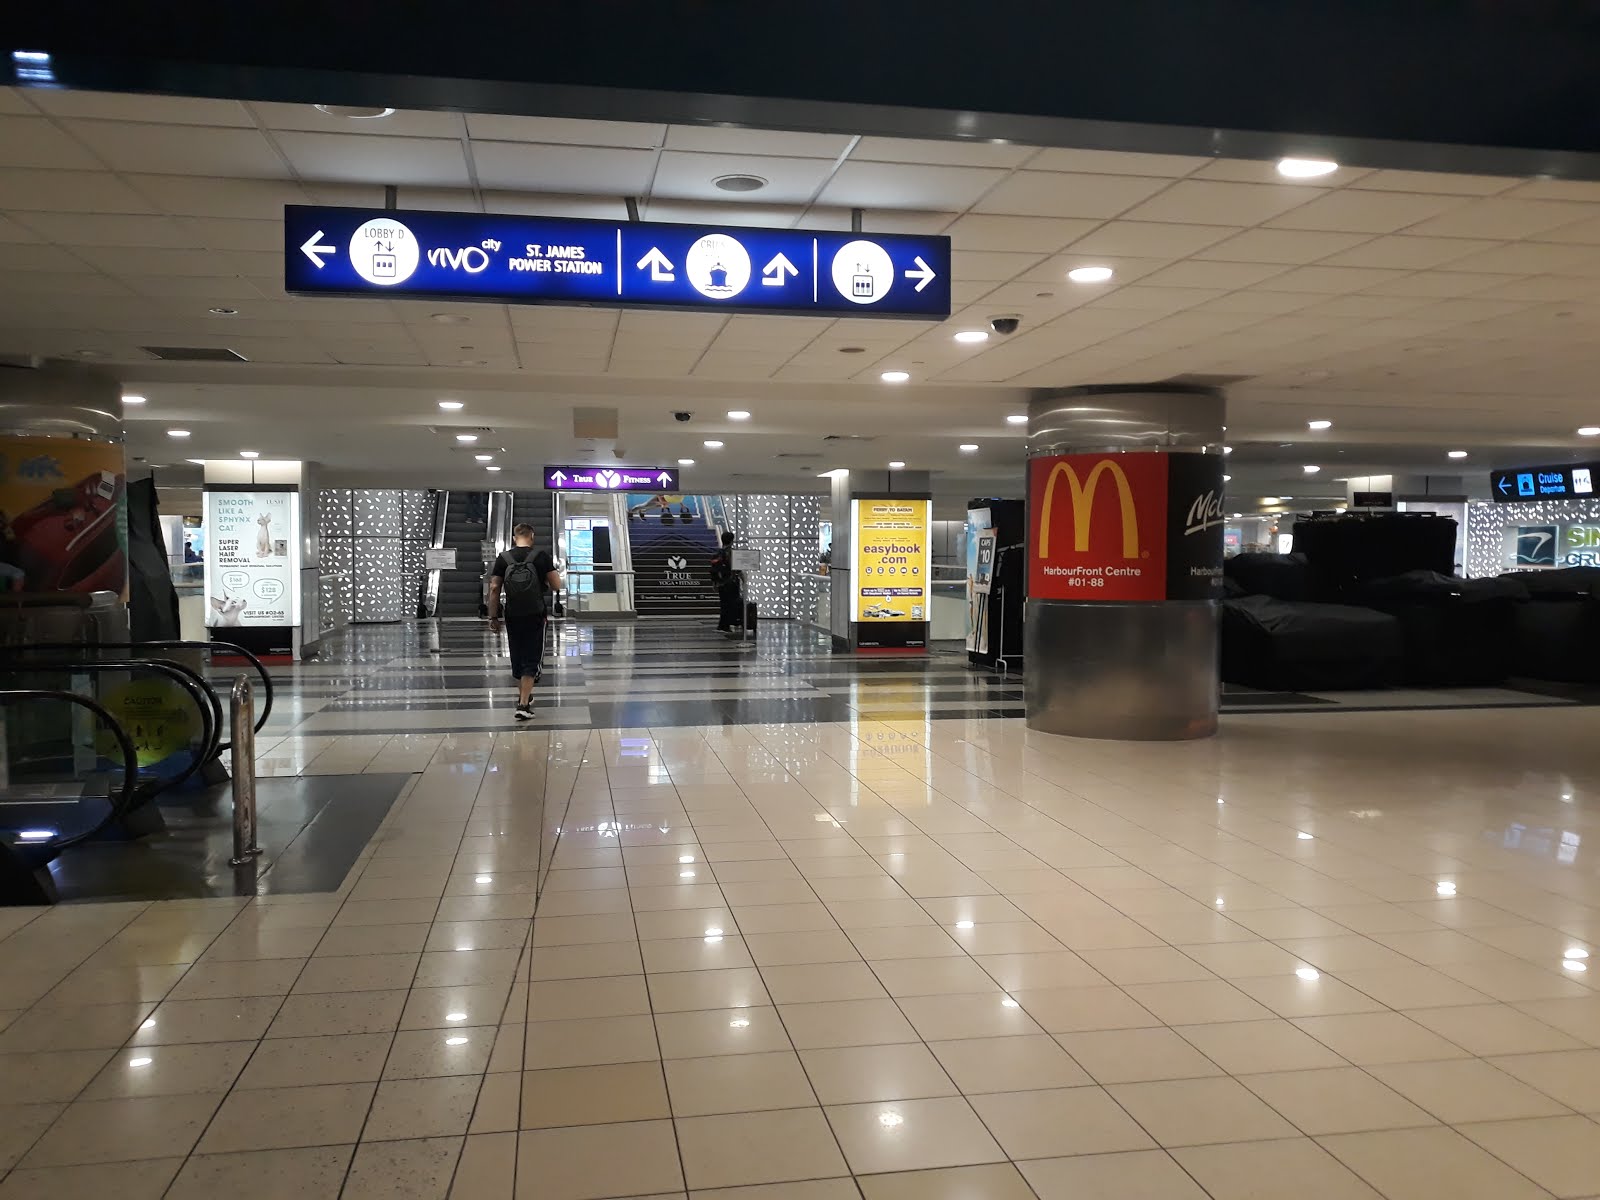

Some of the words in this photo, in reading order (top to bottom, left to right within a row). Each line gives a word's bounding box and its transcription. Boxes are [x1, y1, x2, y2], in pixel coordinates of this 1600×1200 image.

[364, 228, 394, 239] LOBBY
[398, 230, 405, 240] D
[482, 238, 501, 251] city
[526, 244, 543, 257] ST.
[546, 245, 585, 259] JAMES
[508, 258, 551, 272] POWER
[554, 260, 603, 275] STATION
[1538, 472, 1564, 484] Cruise
[863, 543, 921, 556] easybook
[878, 555, 907, 564] .com
[1043, 566, 1102, 576] HarbourFront
[1105, 566, 1141, 576] Centre
[1068, 578, 1104, 587] #01-88
